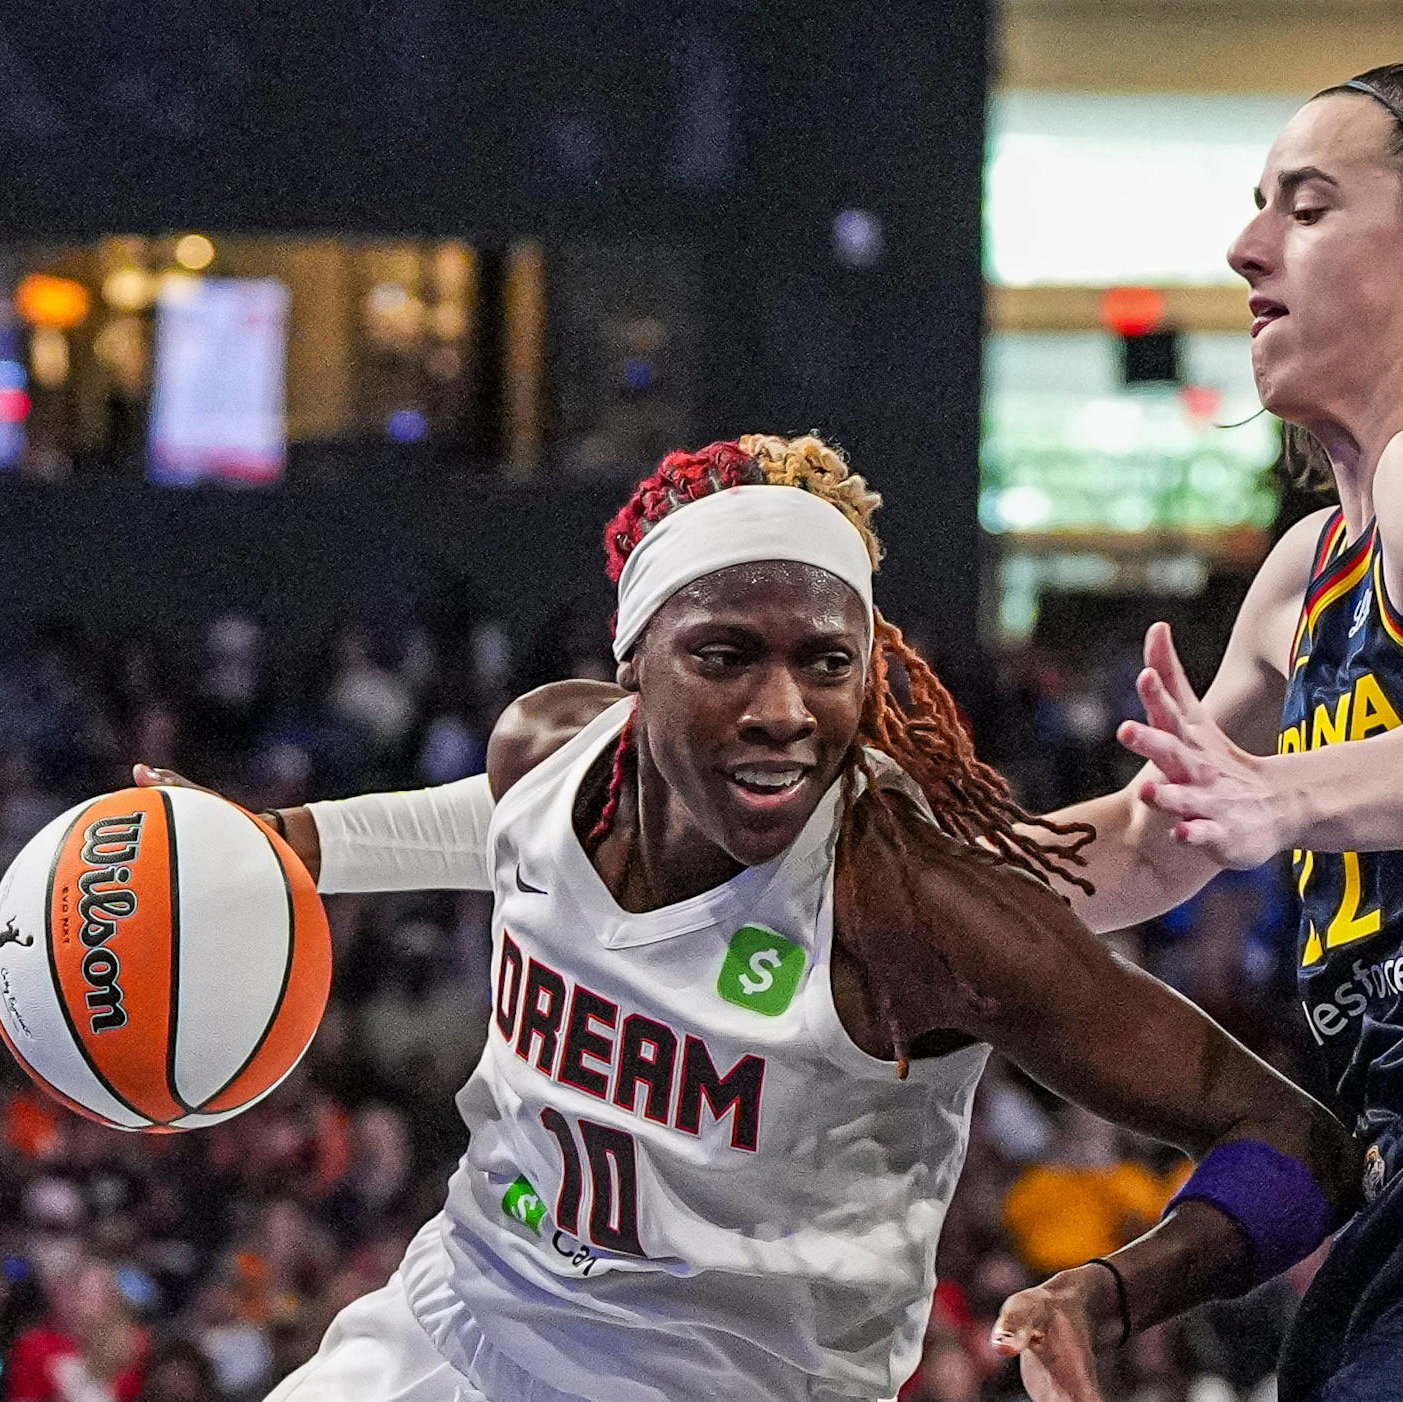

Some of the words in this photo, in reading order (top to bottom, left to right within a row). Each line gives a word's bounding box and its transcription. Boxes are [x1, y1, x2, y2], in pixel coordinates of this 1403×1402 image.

[78, 812, 145, 1035] Wilson
[496, 927, 766, 1152] DREAM
[539, 1106, 650, 1258] 10
